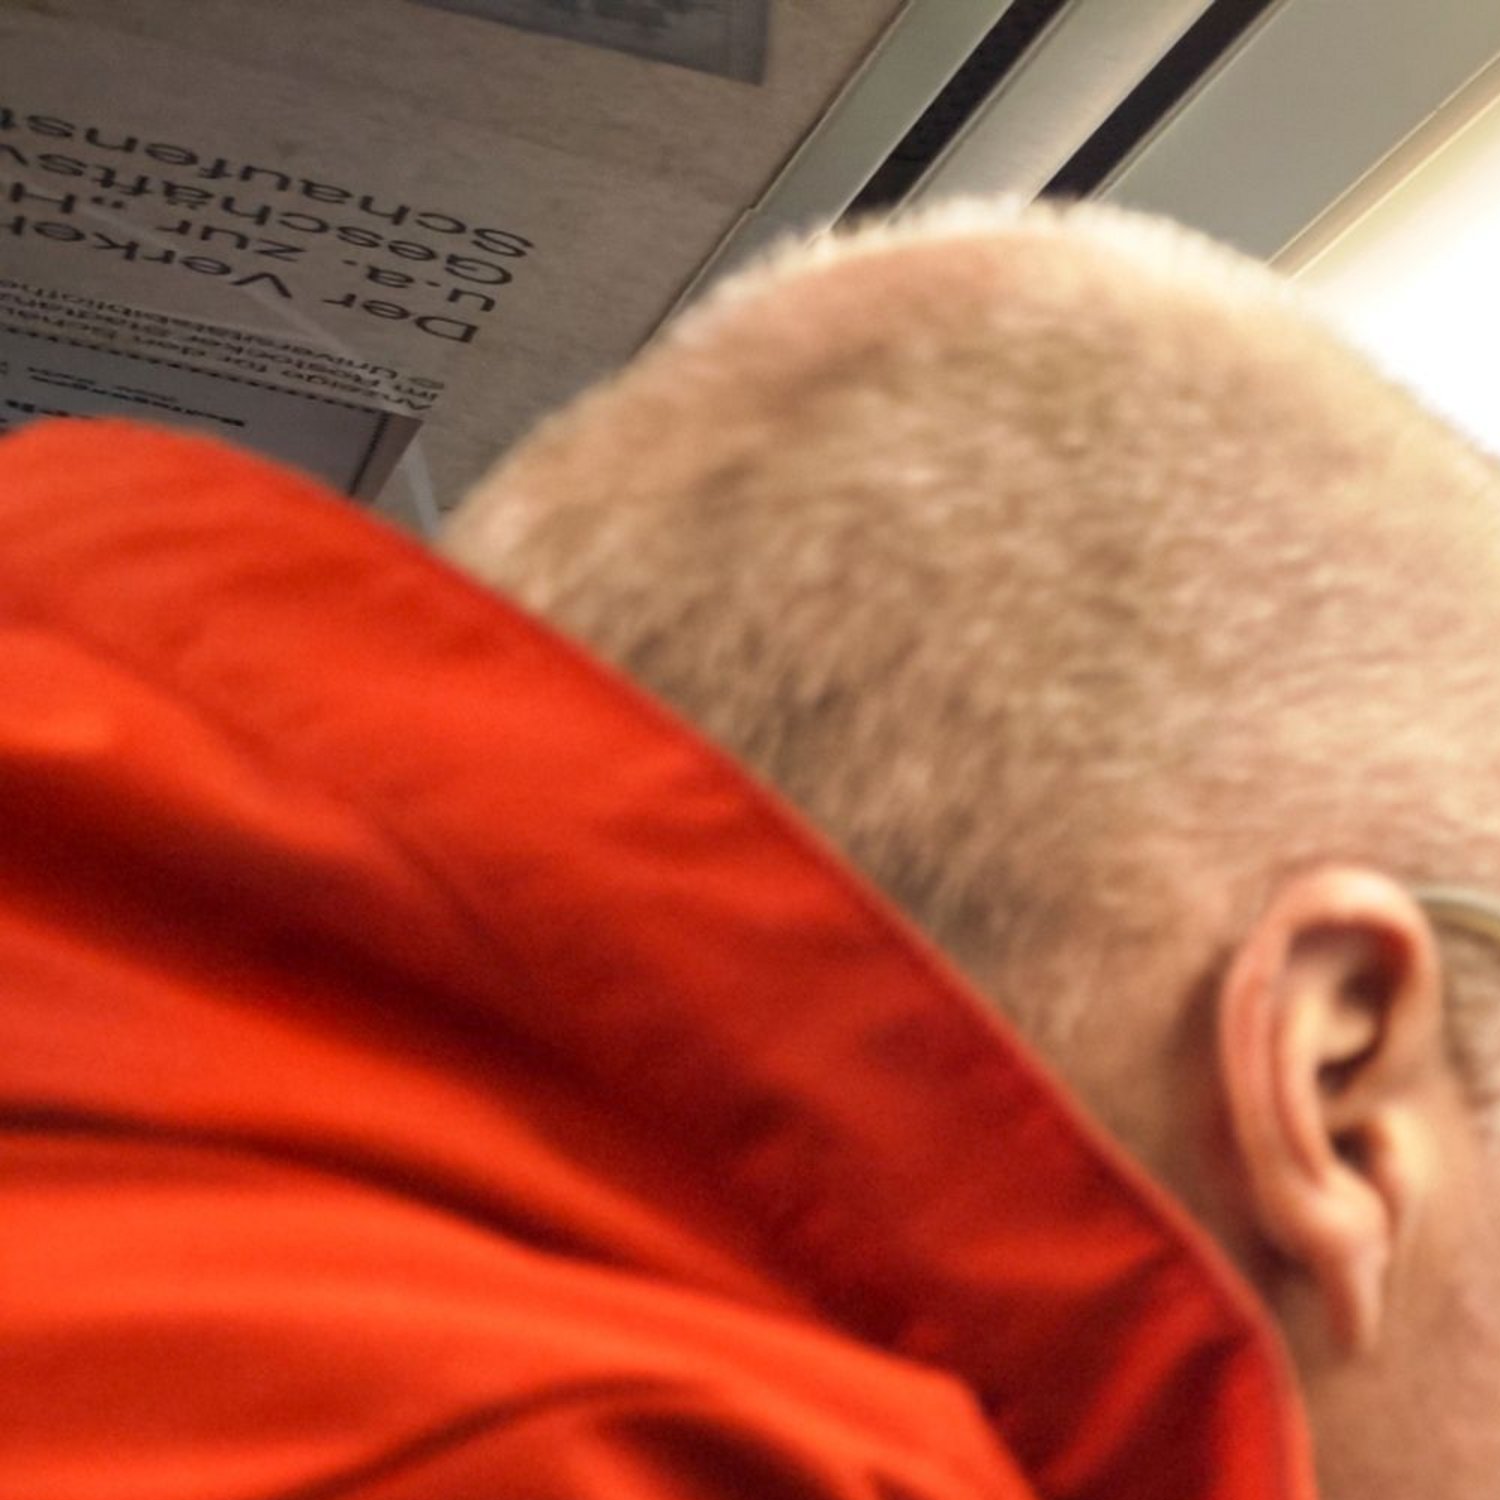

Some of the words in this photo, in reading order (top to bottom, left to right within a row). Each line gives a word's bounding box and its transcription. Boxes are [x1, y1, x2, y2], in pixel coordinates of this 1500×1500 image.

[155, 219, 305, 263] zur
[341, 259, 496, 313] u.a.
[321, 293, 480, 344] Der
